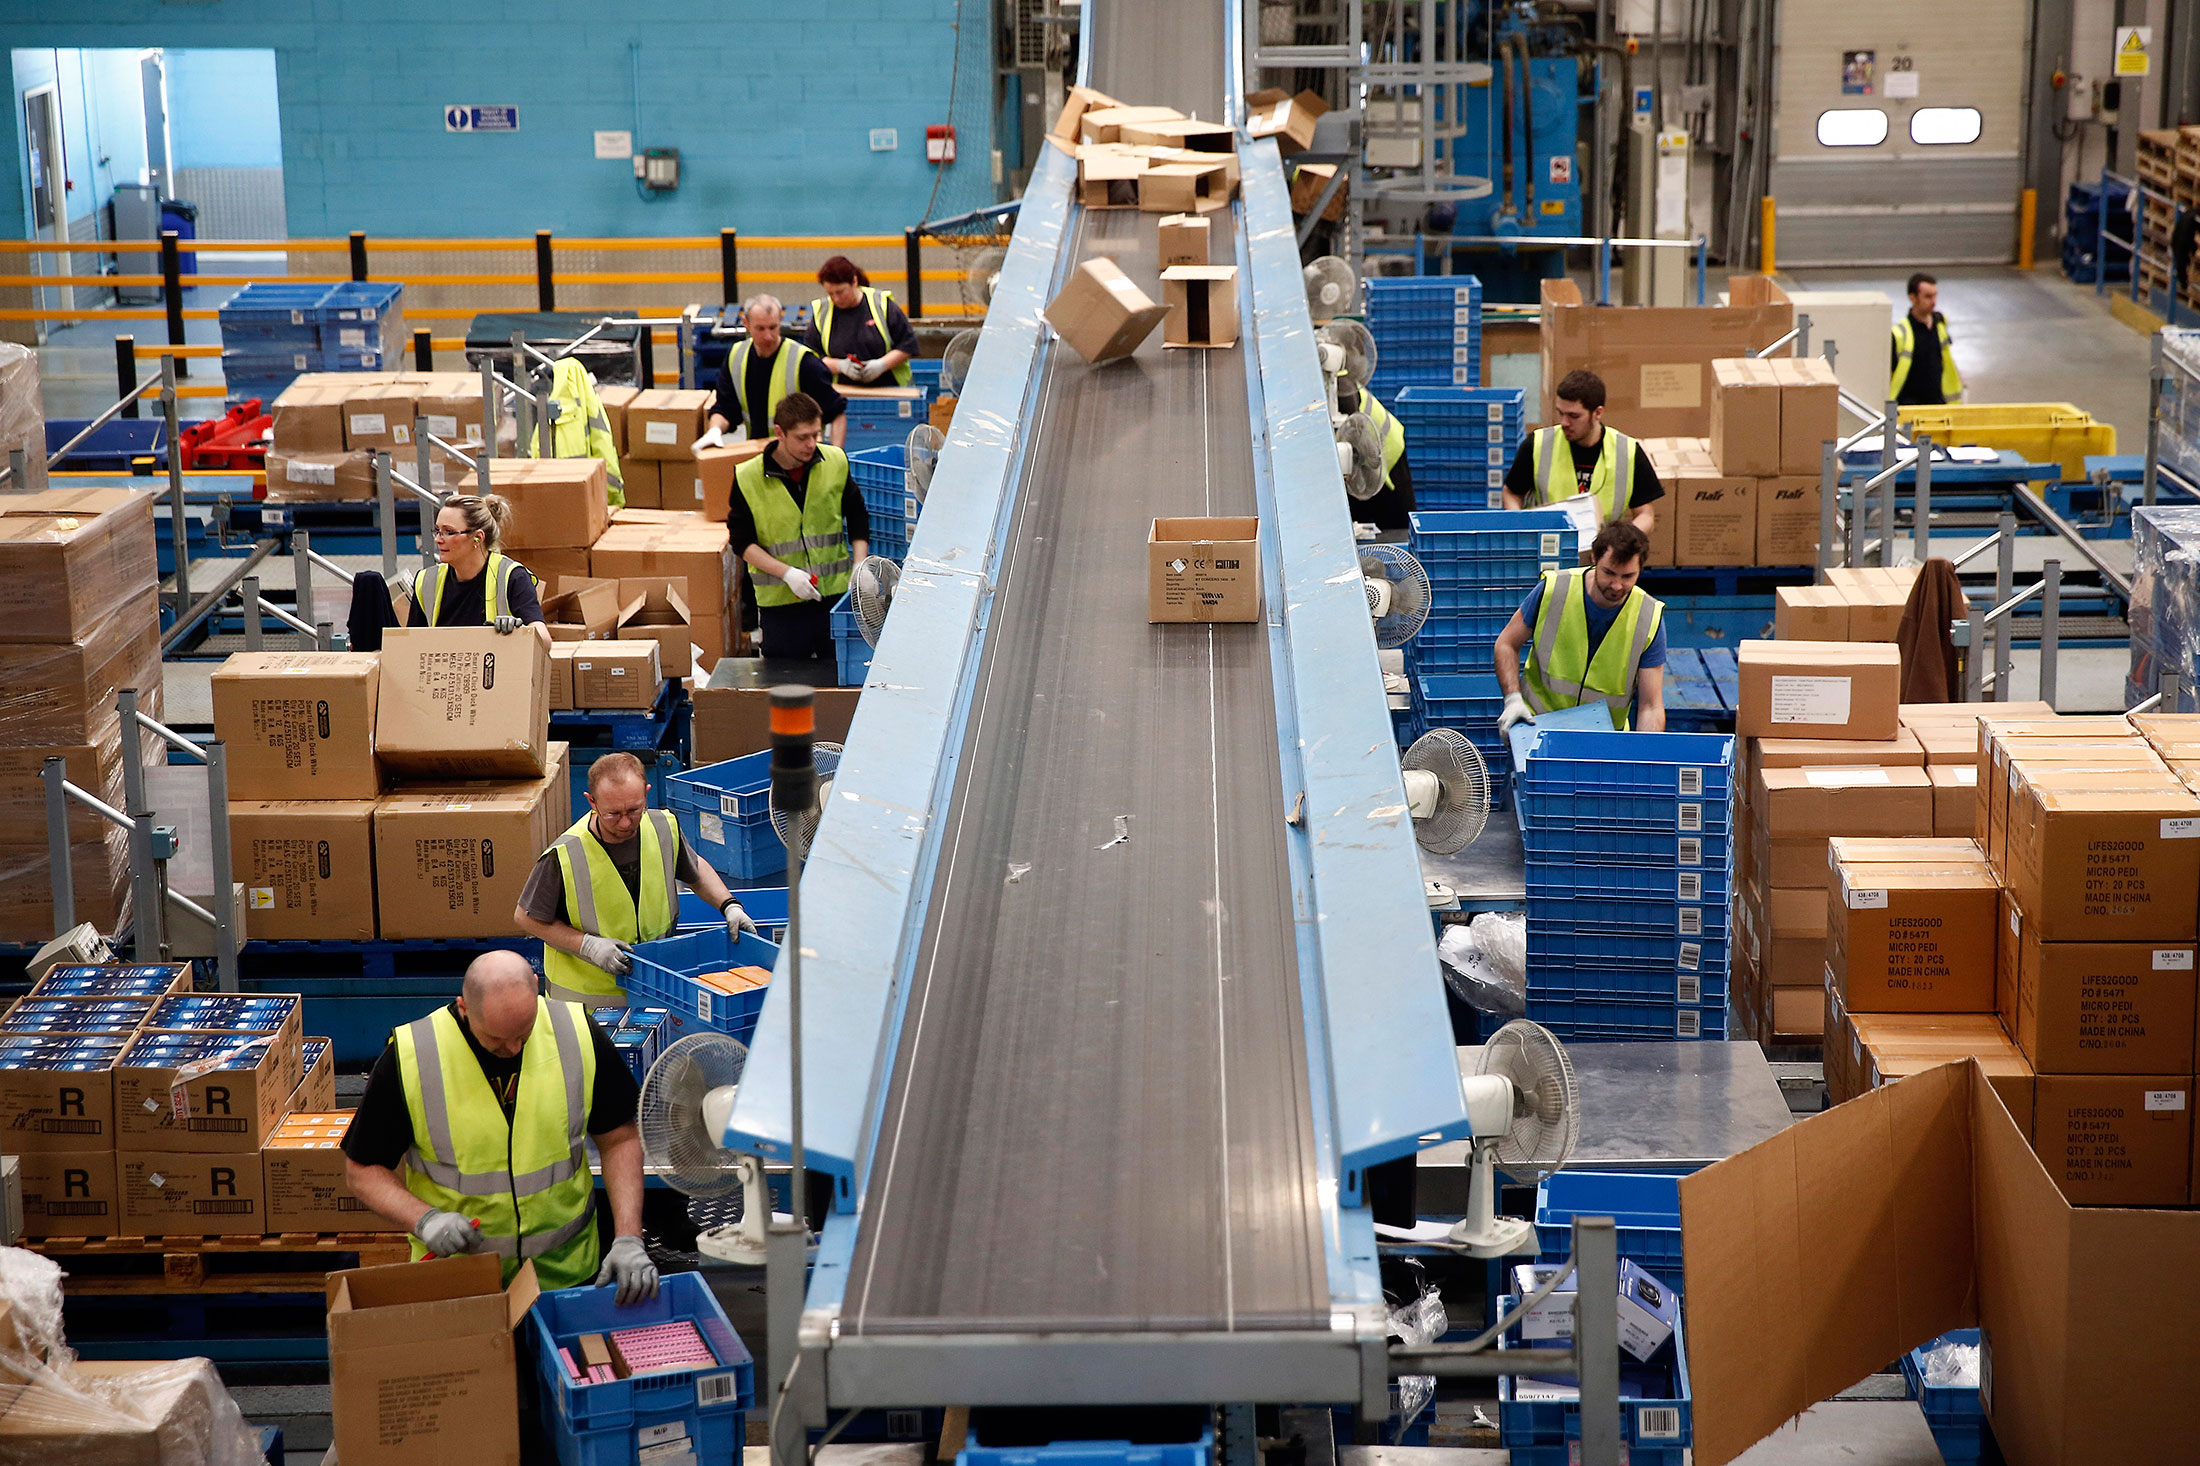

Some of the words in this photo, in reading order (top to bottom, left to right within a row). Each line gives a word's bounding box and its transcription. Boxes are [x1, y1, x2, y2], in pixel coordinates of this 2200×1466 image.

[1892, 56, 1913, 72] 20
[1695, 487, 1724, 501] Flair
[1776, 487, 1805, 499] Flair
[465, 653, 471, 661] PO
[2088, 842, 2144, 851] LIFES2GOOD
[2087, 868, 2115, 876] MICRO
[2118, 868, 2138, 876] PEDI
[2113, 881, 2122, 889] 20
[2127, 881, 2145, 889] PCS
[2085, 893, 2110, 902] MADE
[2113, 893, 2120, 902] IN
[2124, 893, 2151, 902] CHINA
[1889, 919, 1942, 927] LIFES2GOOD
[1889, 943, 1916, 951] MICRO
[1918, 943, 1937, 951] PEDI
[1914, 955, 1923, 964] 20
[1928, 955, 1944, 964] PCS
[1888, 968, 1912, 976] MADE
[1914, 968, 1922, 976] IN
[1924, 968, 1950, 976] CHINA
[2082, 976, 2138, 985] LIFES2GOOD
[2081, 1001, 2110, 1010] MICRO
[2112, 1001, 2132, 1010] PEDI
[2108, 1015, 2117, 1023] 20
[2122, 1015, 2139, 1023] PCS
[2080, 1027, 2105, 1036] MADE
[2108, 1027, 2116, 1036] IN
[2119, 1027, 2145, 1036] CHINA
[60, 1088, 85, 1116] R
[206, 1086, 231, 1114] R
[2068, 1109, 2124, 1118] LIFES2GOOD
[2068, 1134, 2096, 1143] MICRO
[2098, 1134, 2119, 1143] PEDI
[2108, 1147, 2126, 1155] PCS
[2067, 1160, 2091, 1168] MADE
[2094, 1160, 2102, 1168] IN
[2105, 1160, 2133, 1168] CHINA
[64, 1169, 90, 1197] R
[211, 1168, 236, 1195] R
